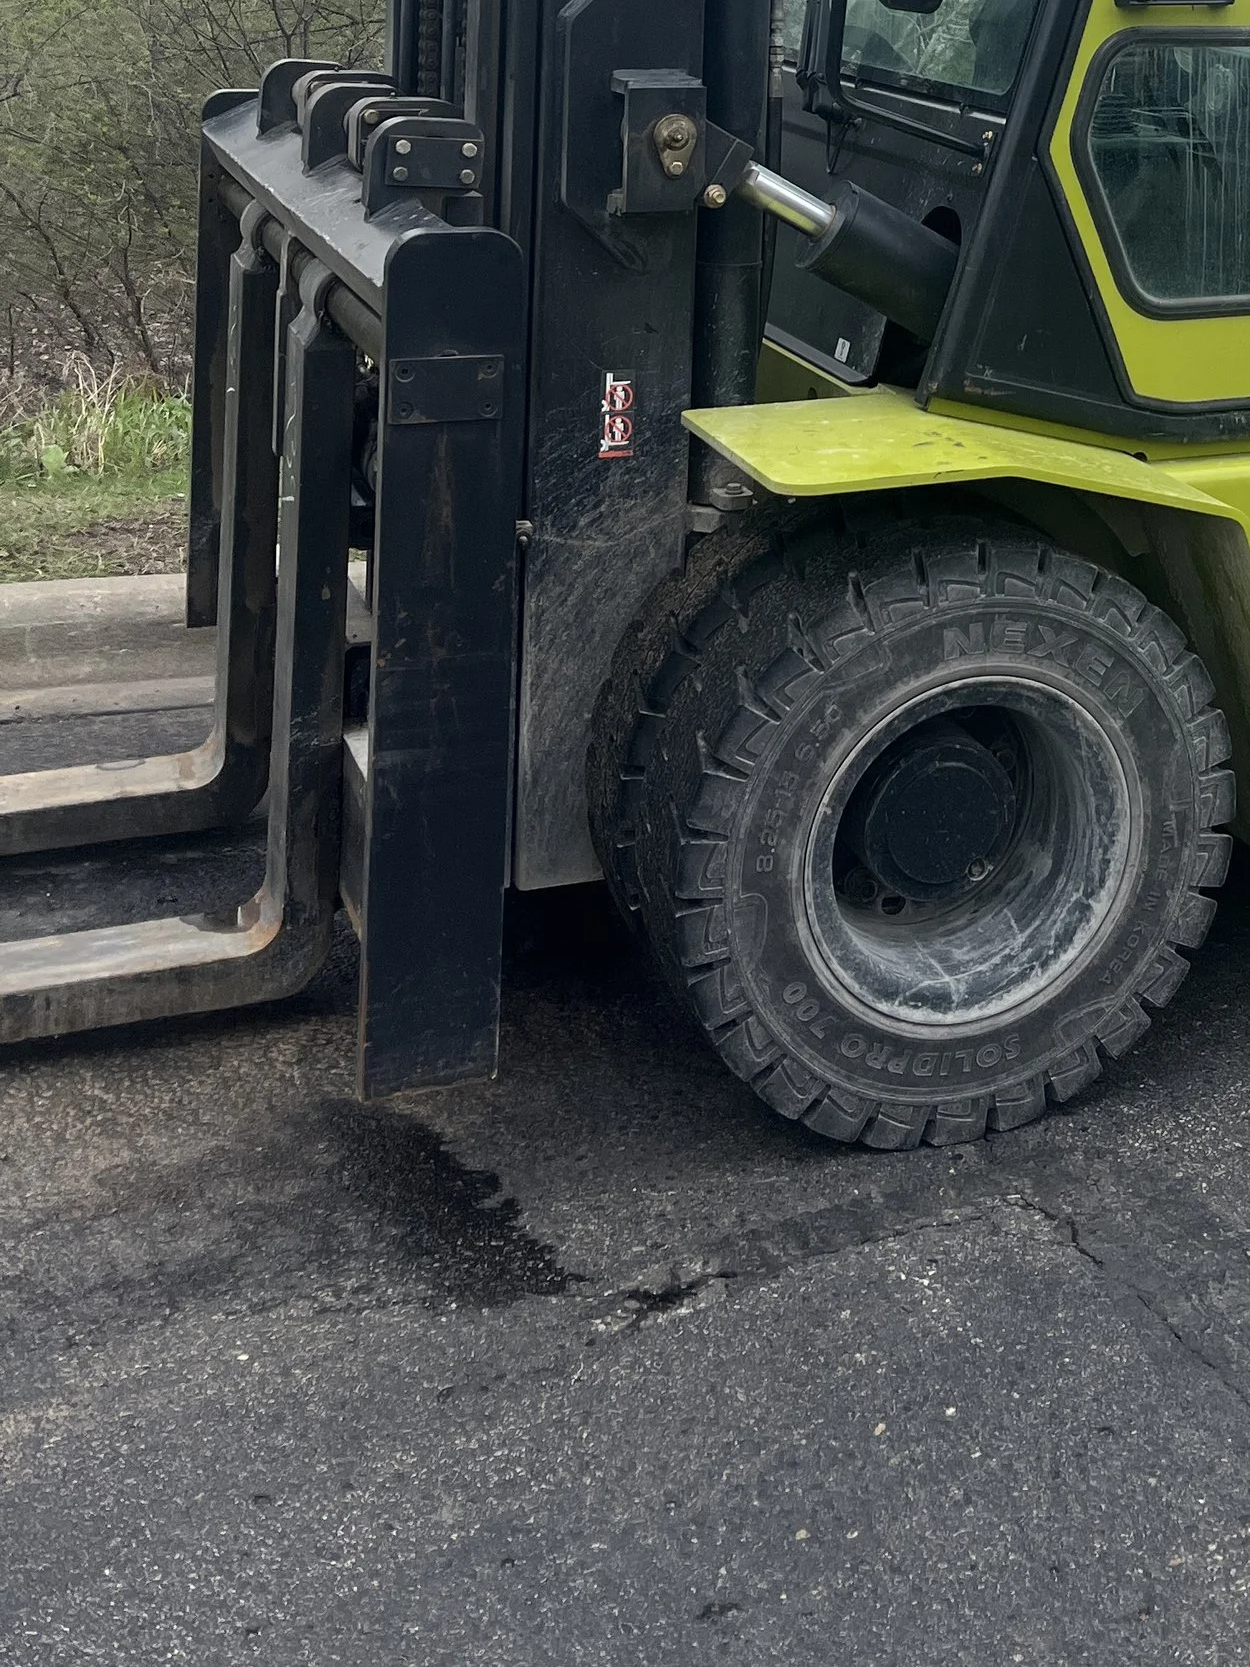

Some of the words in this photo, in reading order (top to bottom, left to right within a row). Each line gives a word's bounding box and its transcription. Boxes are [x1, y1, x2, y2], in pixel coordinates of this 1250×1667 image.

[943, 620, 1146, 720] NEXEN
[1144, 890, 1161, 912] IN
[783, 981, 836, 1040] 700
[841, 1033, 1021, 1076] SOLIDPRO
